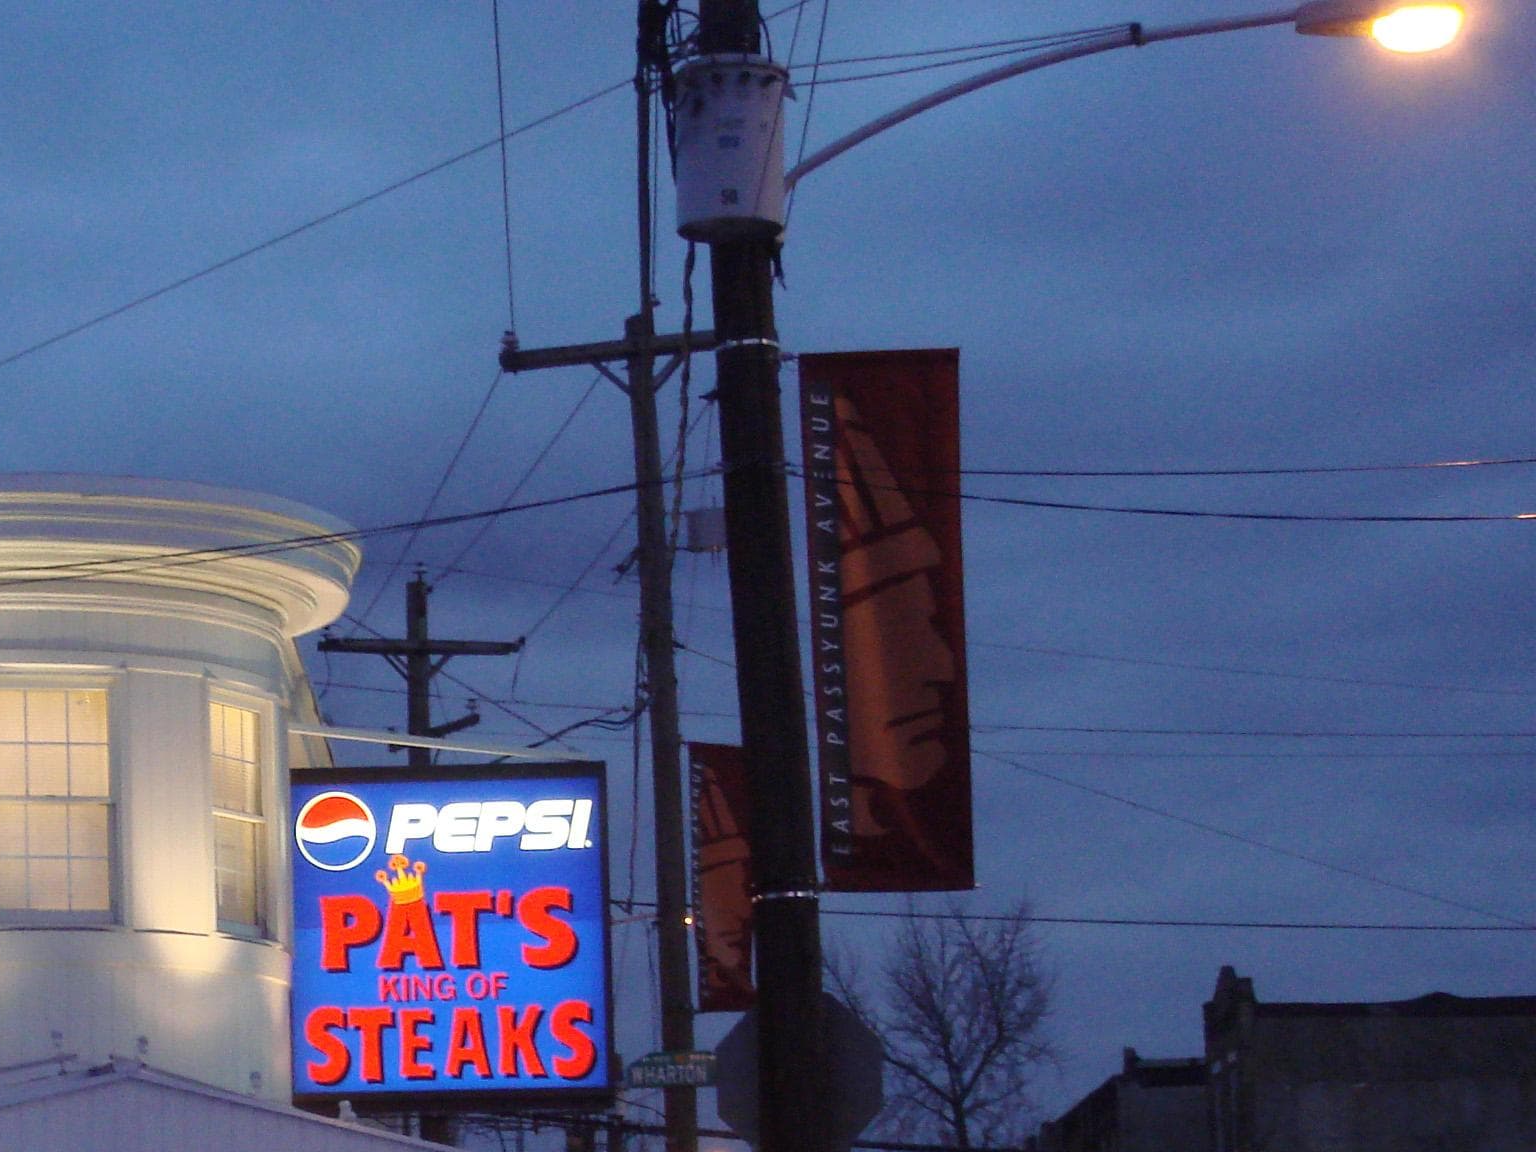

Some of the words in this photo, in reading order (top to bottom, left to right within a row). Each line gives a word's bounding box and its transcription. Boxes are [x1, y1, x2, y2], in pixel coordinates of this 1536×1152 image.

[809, 394, 835, 534] AVENUE
[816, 560, 845, 745] PASSYUNK
[385, 799, 592, 855] PEPSI
[828, 773, 850, 855] EAST
[319, 886, 578, 972] PAT'S
[378, 973, 456, 1002] KING
[465, 972, 509, 1000] OF
[304, 1000, 597, 1085] STEAKS
